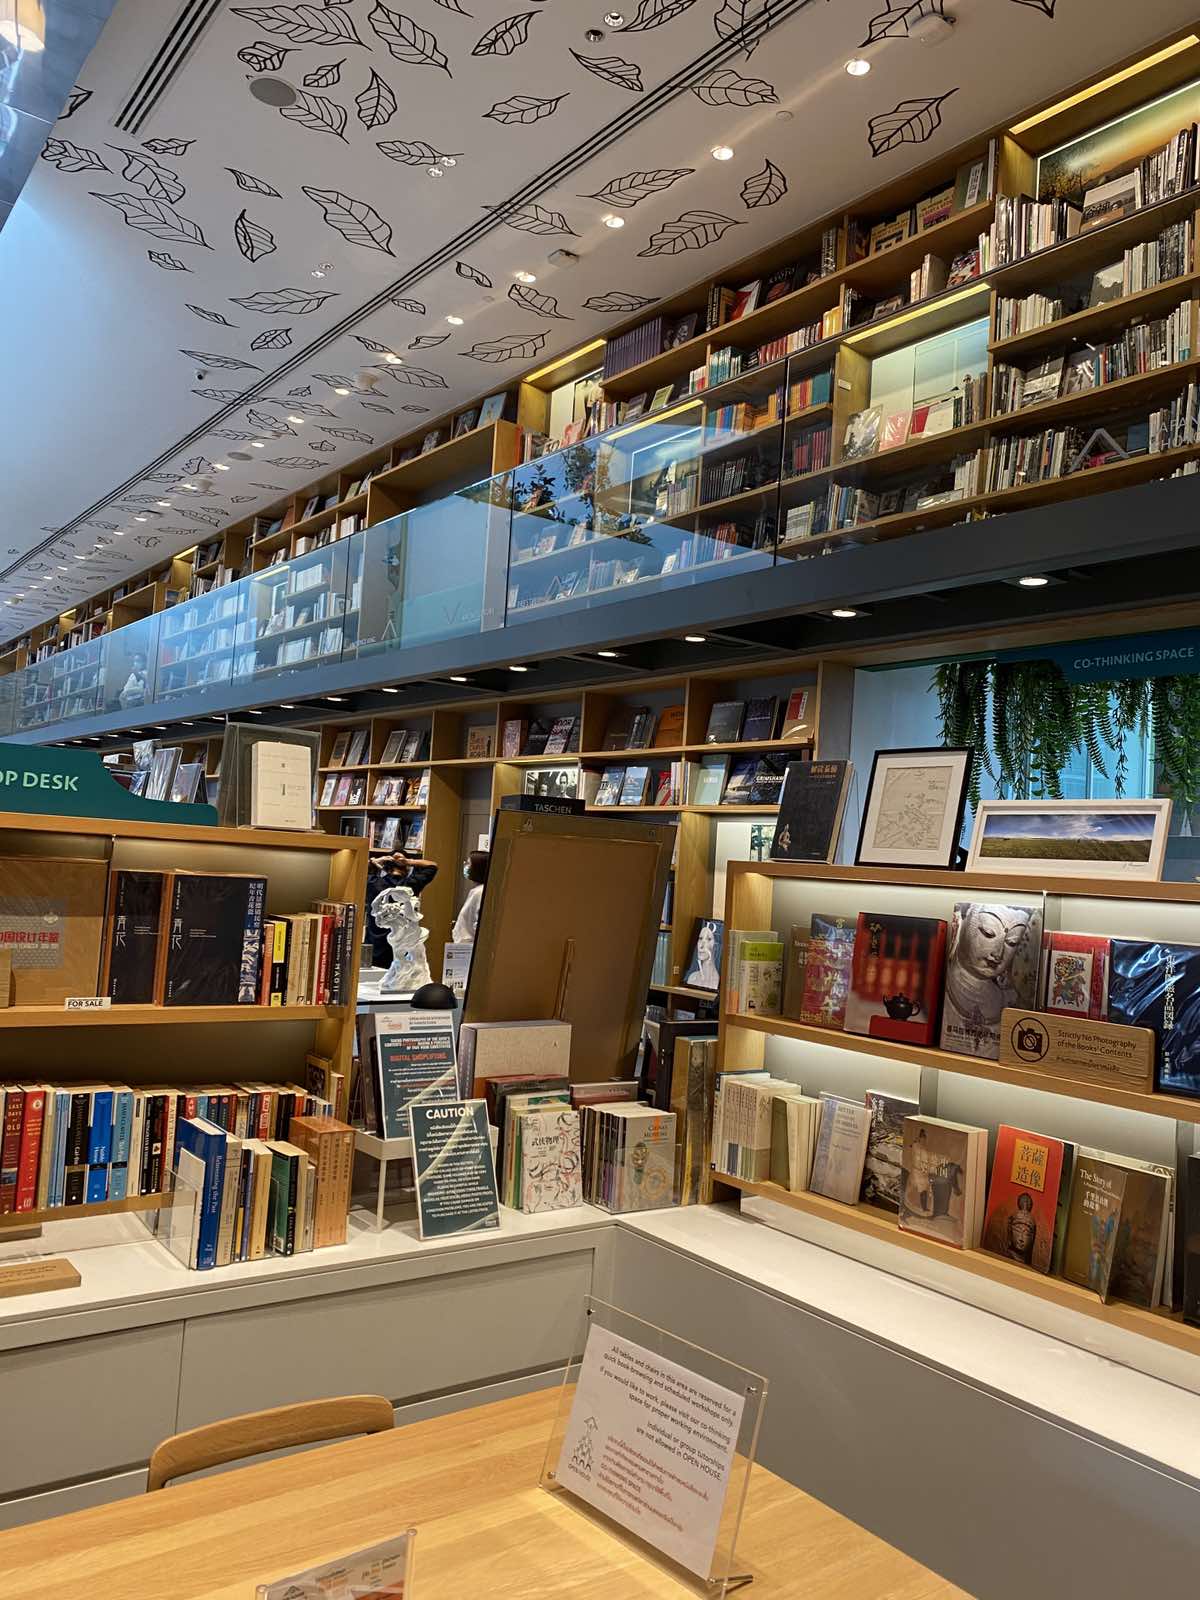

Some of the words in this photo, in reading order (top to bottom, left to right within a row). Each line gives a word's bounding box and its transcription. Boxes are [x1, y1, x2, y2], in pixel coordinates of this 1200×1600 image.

[1073, 650, 1153, 670] CO-THINKING
[1155, 647, 1195, 660] SPACE
[22, 771, 79, 791] DESK
[534, 803, 572, 814] TASCHEN
[67, 1000, 82, 1008] FOR
[83, 1000, 103, 1008] SALE
[1056, 1030, 1081, 1040] Strictly
[1092, 1035, 1137, 1049] Photography
[1100, 1046, 1132, 1058] Contents
[426, 1106, 474, 1120] CAUTION
[212, 1155, 223, 1190] Reinventing
[1079, 1168, 1092, 1181] The
[619, 1349, 634, 1362] tables
[635, 1358, 645, 1367] and
[645, 1363, 659, 1376] chairs
[665, 1373, 676, 1384] this
[698, 1392, 722, 1409] reserved
[614, 1374, 629, 1386] would
[629, 1381, 639, 1392] like
[660, 1400, 677, 1413] please
[678, 1409, 689, 1420] visit
[654, 1379, 664, 1389] and
[664, 1385, 690, 1403] scheduled
[691, 1399, 720, 1420] workshops
[629, 1392, 643, 1406] space
[651, 1406, 670, 1420] proper
[670, 1416, 692, 1433] working
[647, 1421, 673, 1441] Individual
[680, 1440, 696, 1455] group
[697, 1449, 724, 1471] tutorships
[655, 1438, 676, 1454] allowed
[682, 1453, 699, 1468] OPEN
